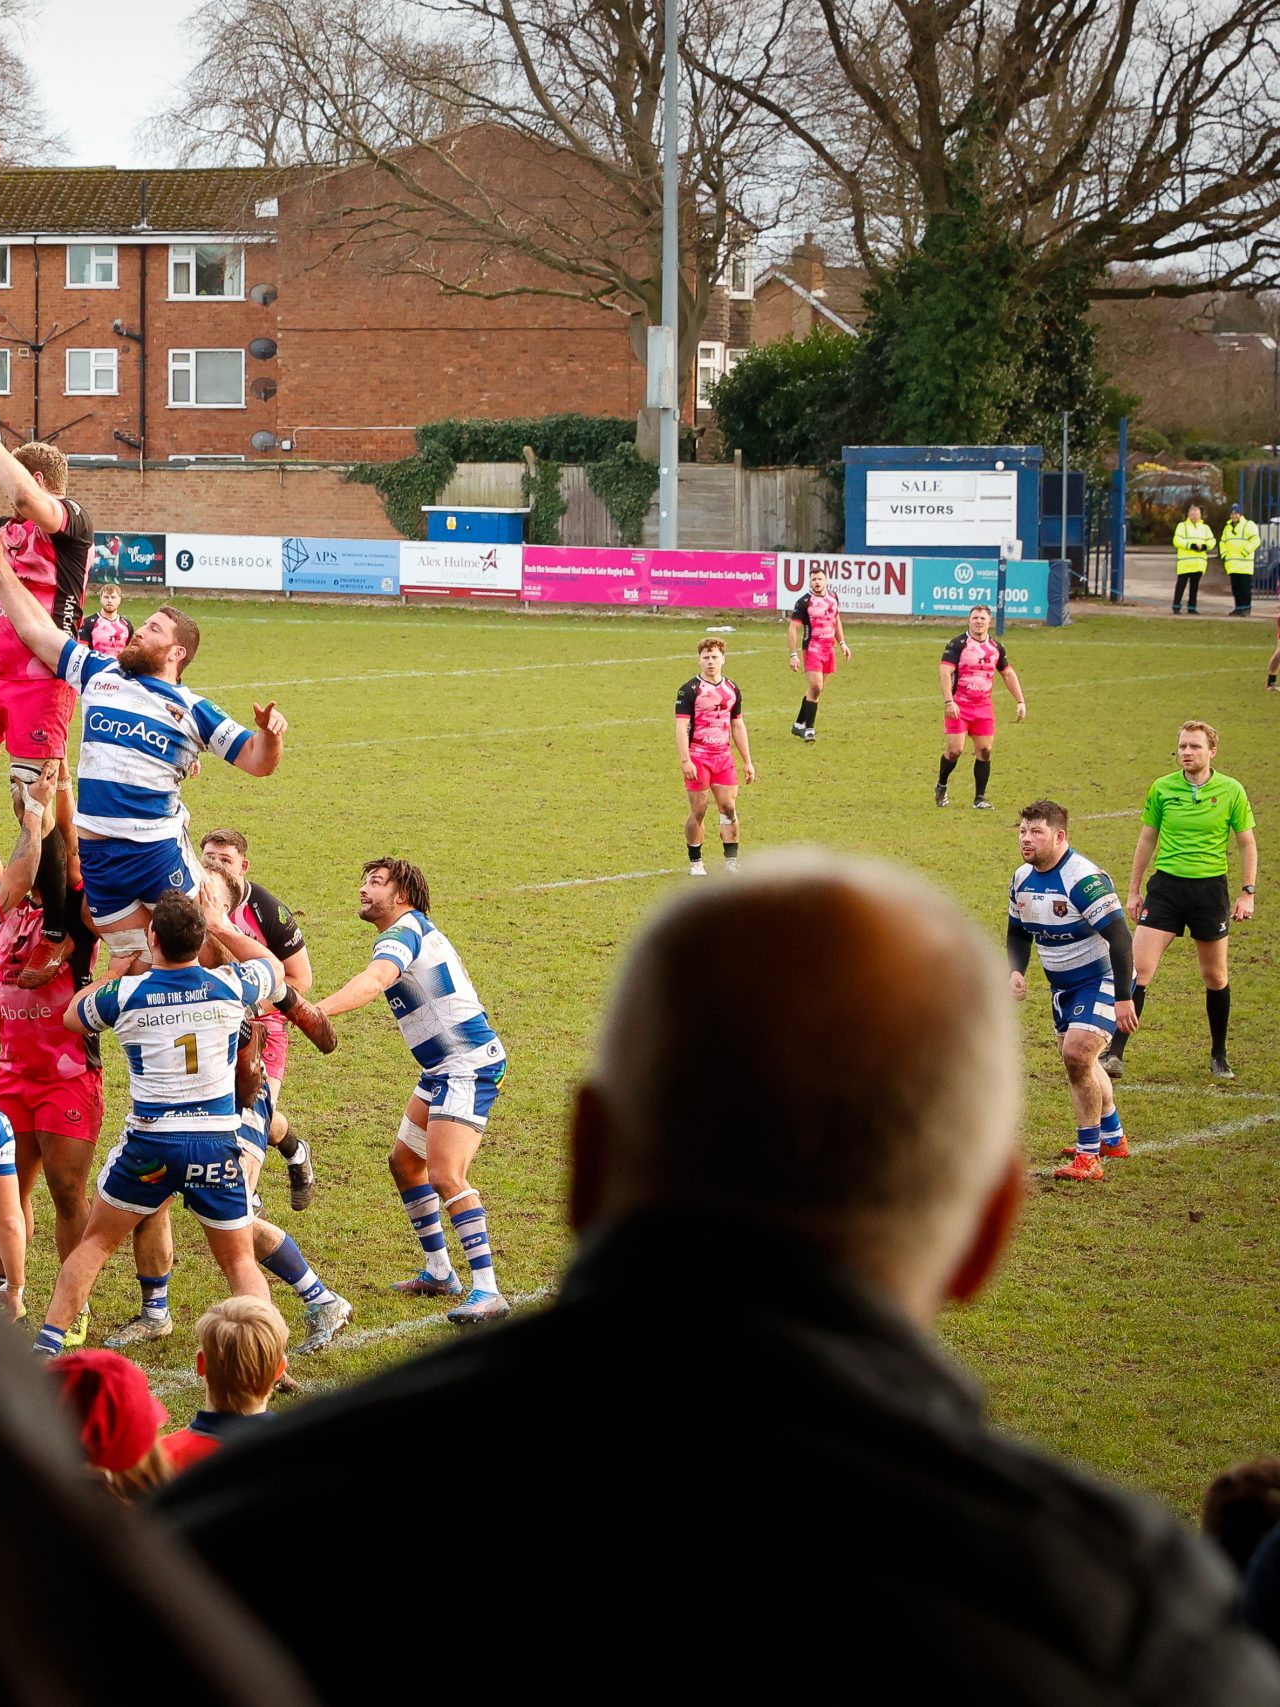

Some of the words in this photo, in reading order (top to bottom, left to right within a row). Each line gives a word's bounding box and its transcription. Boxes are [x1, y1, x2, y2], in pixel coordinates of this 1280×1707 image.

[901, 480, 943, 492] SALE
[890, 505, 953, 515] VISITORS
[199, 555, 273, 568] GLENBROOK
[313, 551, 337, 562] APS
[417, 555, 440, 567] Alex
[444, 556, 480, 568] Hulme
[866, 585, 880, 595] Ltd
[933, 586, 963, 600] 0161
[968, 587, 992, 601] 971
[94, 681, 120, 691] Cotton
[90, 711, 170, 754] CorpAcq
[146, 993, 166, 1006] WOOD
[167, 991, 183, 1004] FIRE
[185, 988, 209, 1002] SMOKE
[0, 1003, 51, 1020] Abode
[137, 1005, 230, 1028] slaterheelis
[174, 1032, 199, 1075] 1
[185, 1159, 238, 1183] PES
